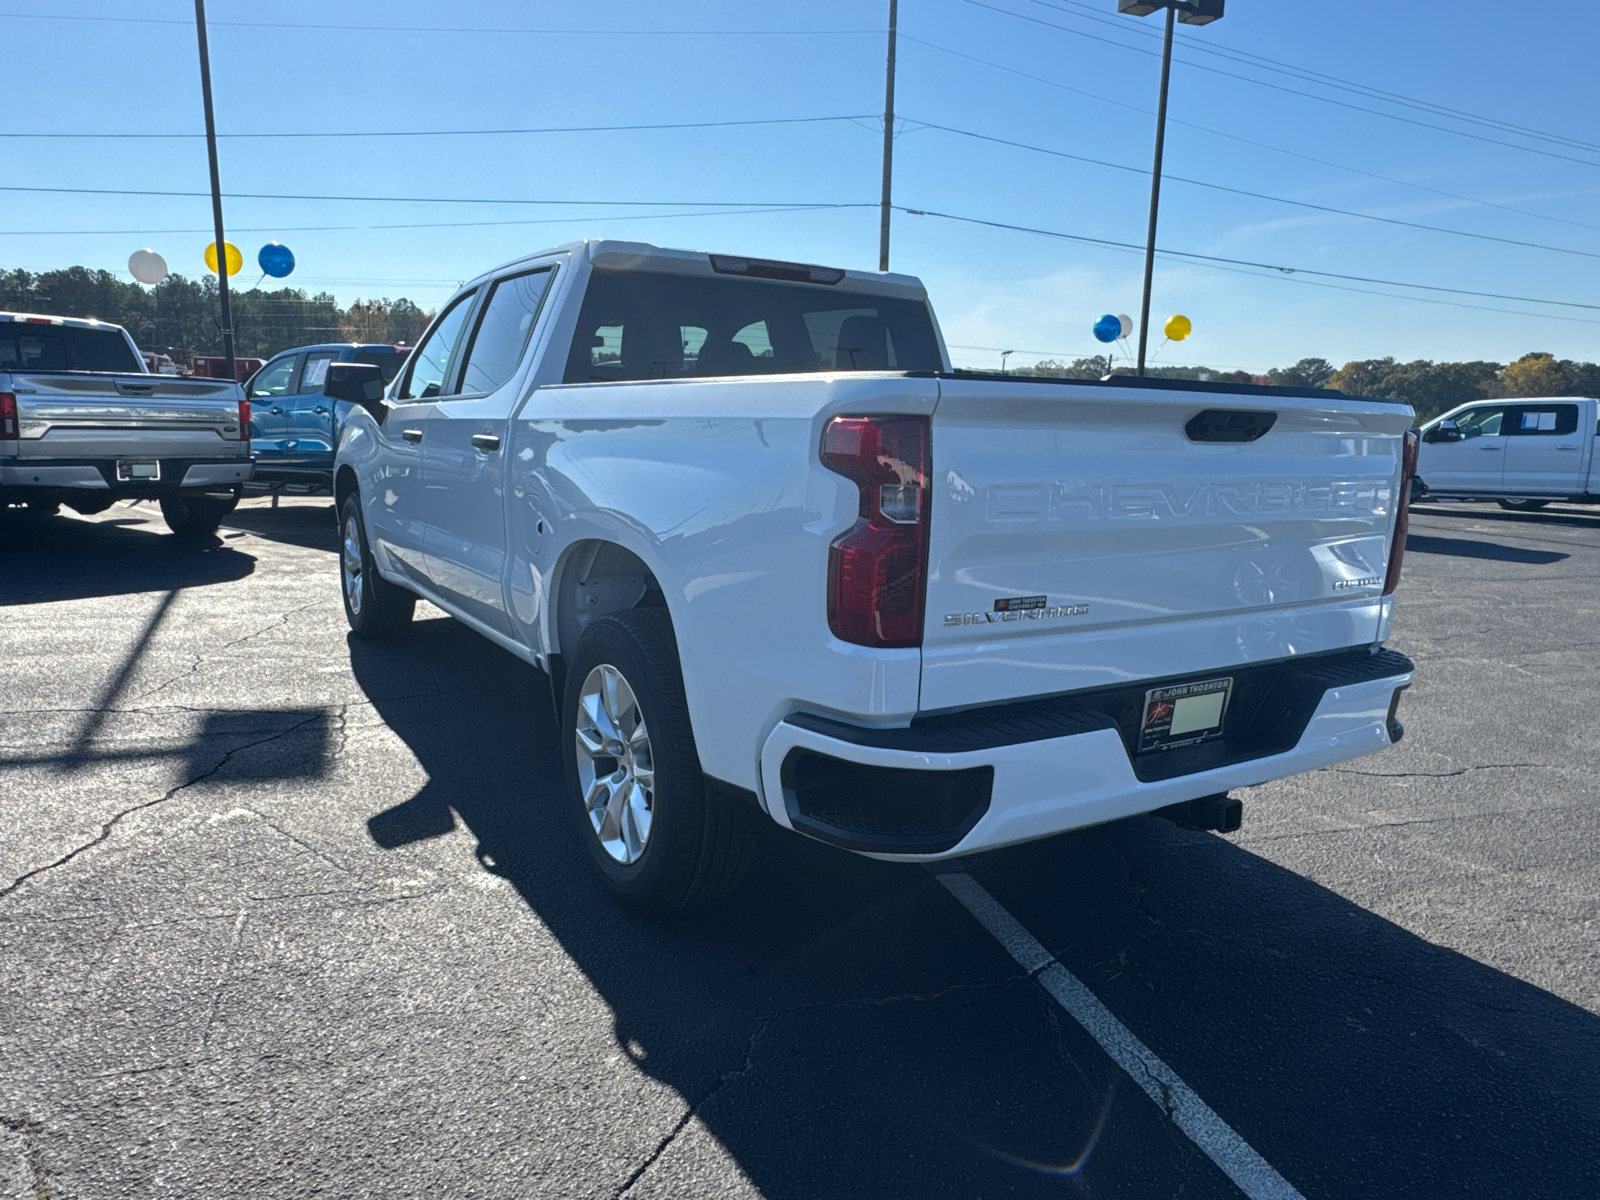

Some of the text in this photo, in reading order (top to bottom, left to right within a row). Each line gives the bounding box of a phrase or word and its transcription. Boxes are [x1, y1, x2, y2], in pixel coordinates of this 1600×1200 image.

[985, 479, 1391, 523] CHEVROLET
[943, 603, 1090, 627] SILVERADO
[1008, 602, 1037, 610] CHEVROLET
[1166, 680, 1229, 698] JOHN THORNTON
